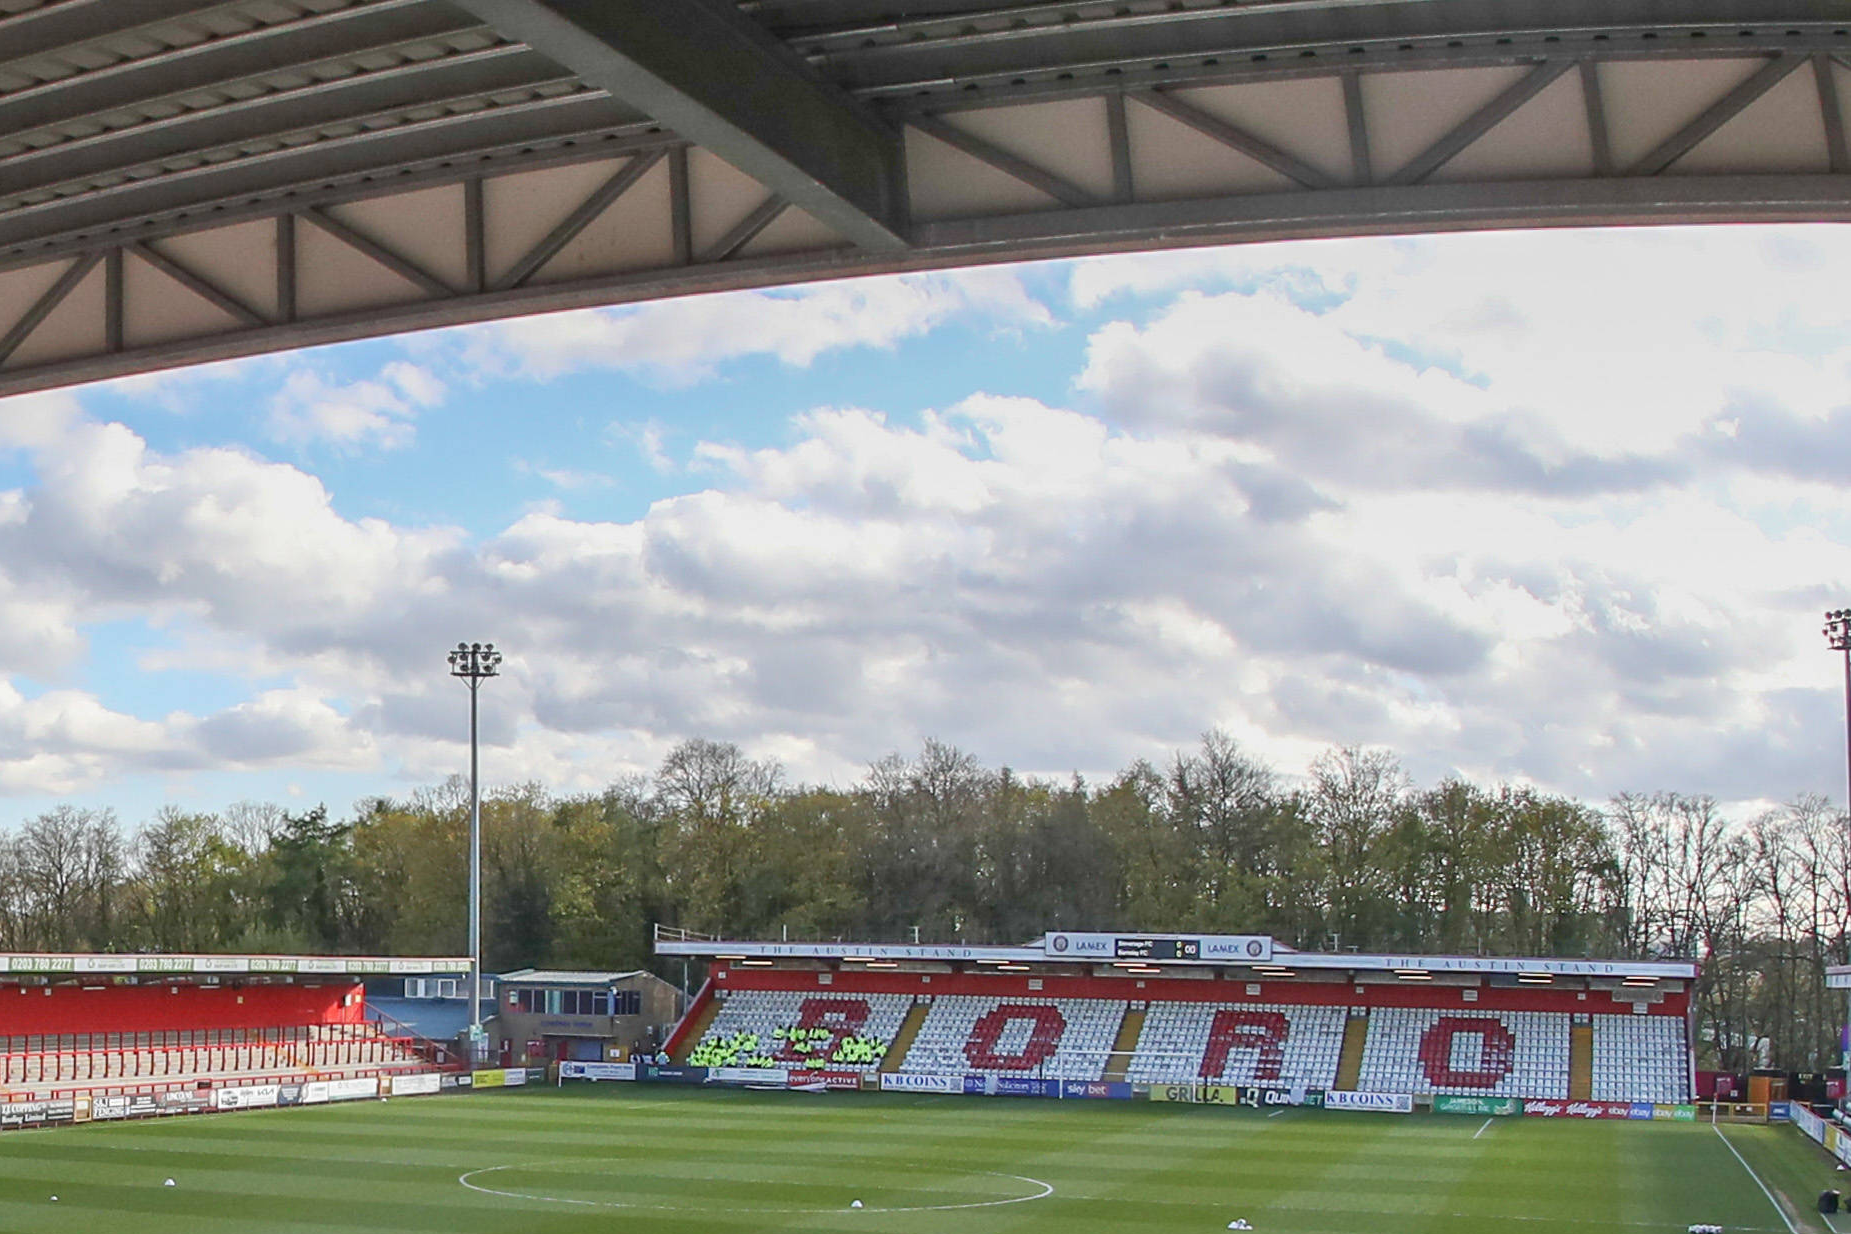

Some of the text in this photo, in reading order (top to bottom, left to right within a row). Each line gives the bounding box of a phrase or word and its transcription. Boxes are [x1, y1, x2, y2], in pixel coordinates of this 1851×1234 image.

[812, 947, 888, 955] AUSTIN
[906, 948, 972, 957] STAND
[1076, 942, 1108, 951] LAMEX
[1207, 944, 1238, 953] LAMEX
[12, 958, 33, 970] 0203
[51, 958, 72, 970] 2277
[1385, 959, 1614, 973] THE AUSTIN STAND
[884, 1075, 947, 1087] K B COINS
[1067, 1083, 1107, 1096] sky bet
[1327, 1093, 1393, 1105] K B COINS
[1524, 1100, 1605, 1118] Kellogg's Kellogg's
[1608, 1106, 1695, 1119] ebay ebay ebay ebay
